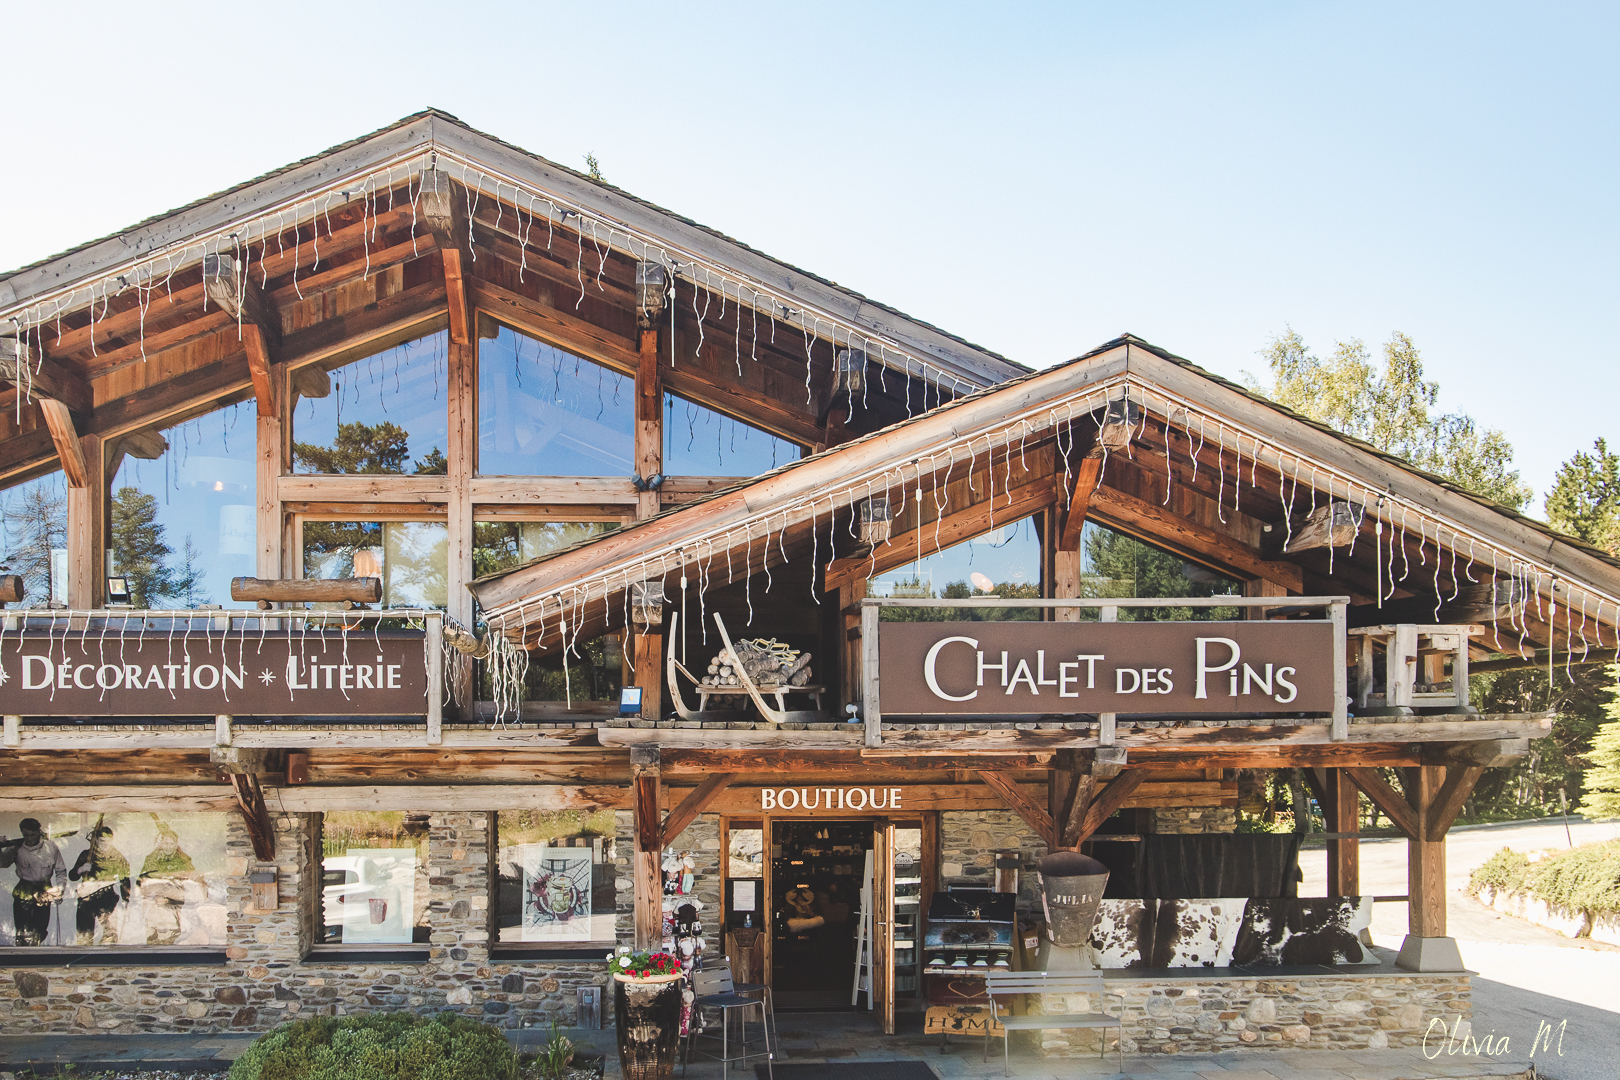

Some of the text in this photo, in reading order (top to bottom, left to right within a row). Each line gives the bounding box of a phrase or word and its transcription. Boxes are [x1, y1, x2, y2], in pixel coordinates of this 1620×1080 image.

[924, 636, 1105, 702] CHALET
[1115, 667, 1174, 695] DES
[761, 788, 902, 811] BOUTIQUE
